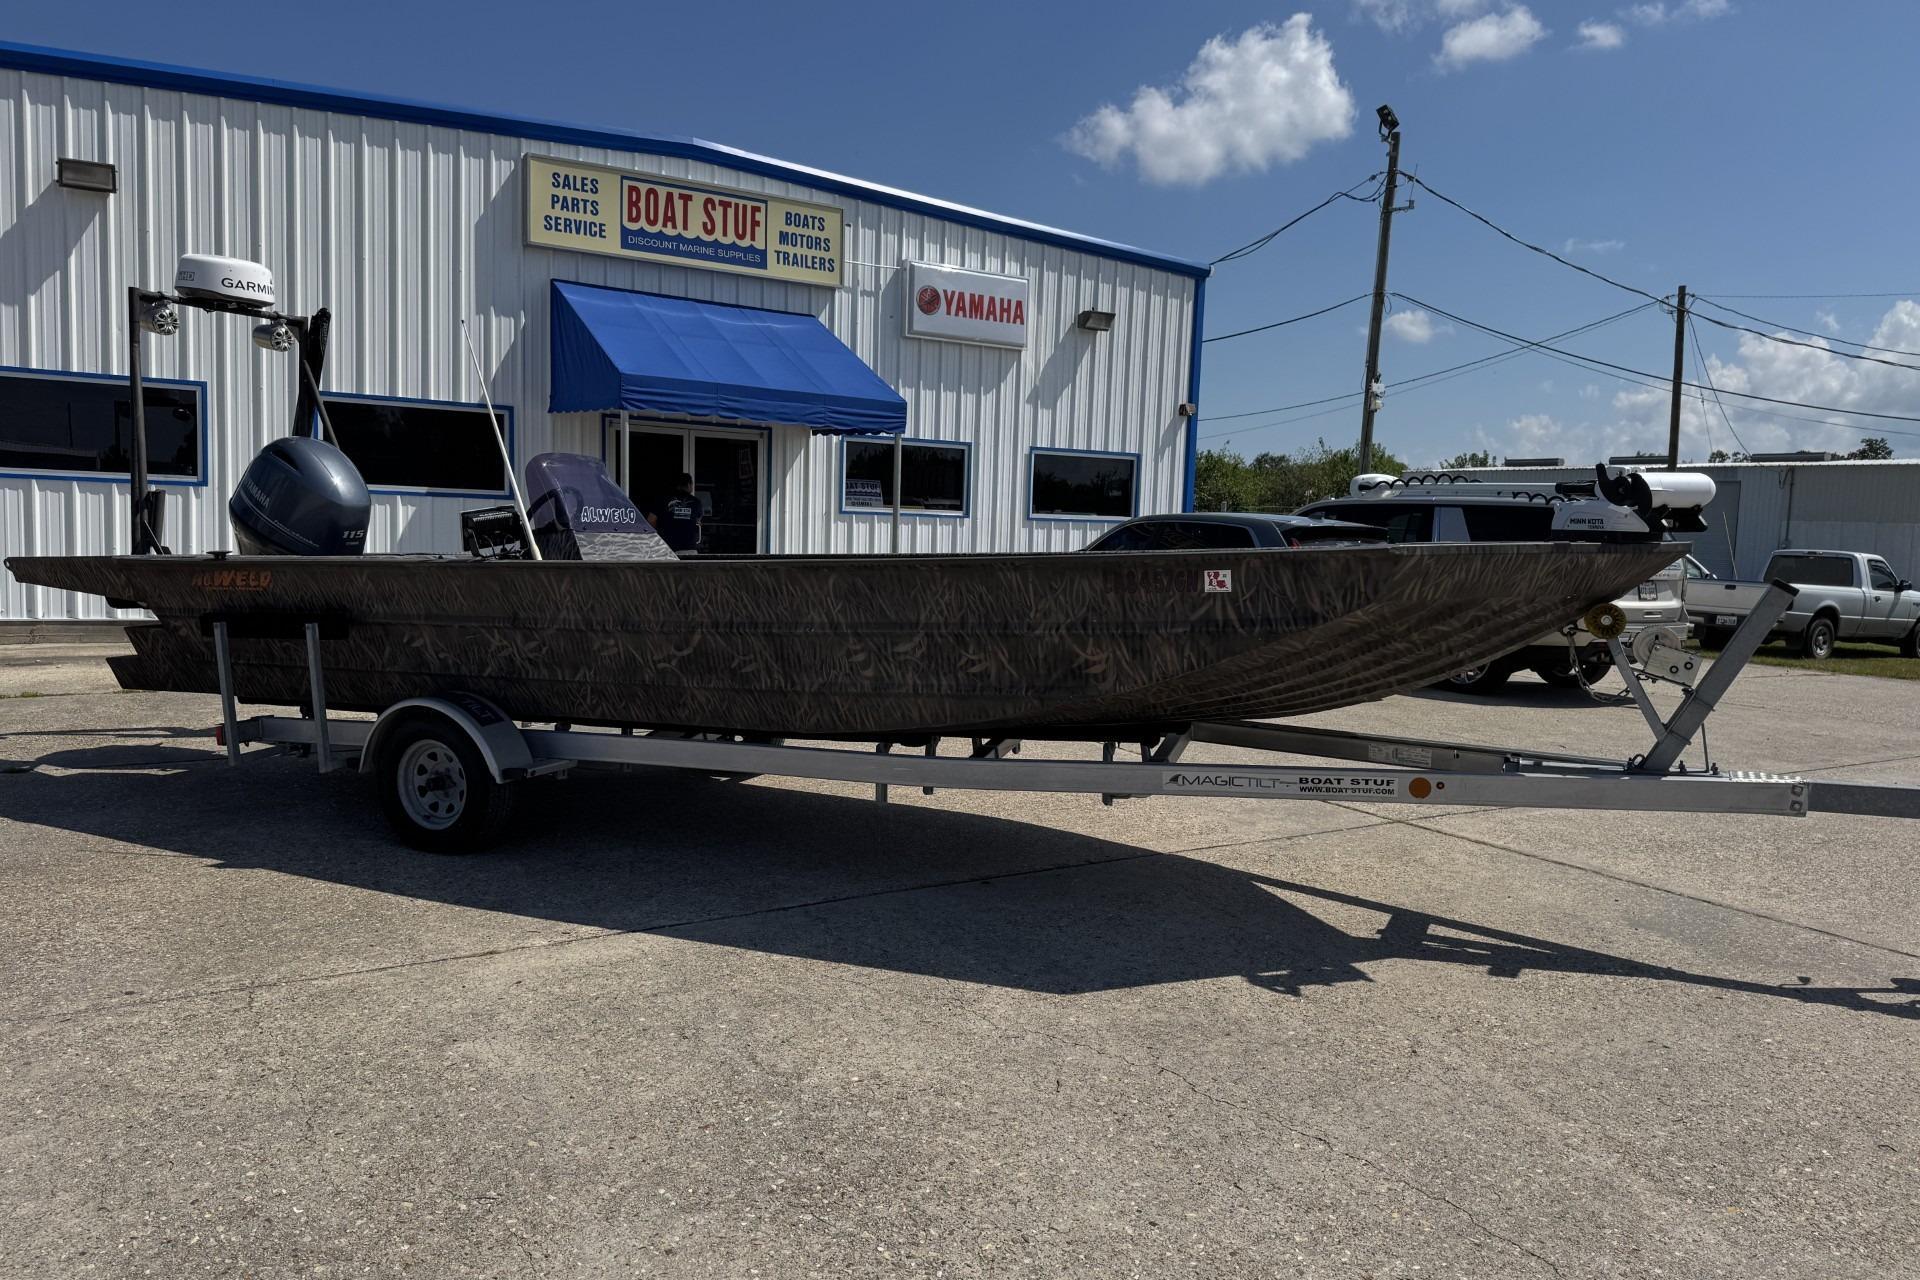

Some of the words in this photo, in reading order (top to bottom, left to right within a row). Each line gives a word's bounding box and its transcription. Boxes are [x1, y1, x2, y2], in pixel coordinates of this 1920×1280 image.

[551, 172, 599, 194] SALES
[551, 193, 599, 216] PARTS
[627, 184, 693, 231] BOAT
[702, 197, 762, 242] STUF
[543, 214, 607, 239] SERVICE
[785, 211, 825, 232] BOATS
[628, 235, 678, 251] DISCOUNT
[680, 243, 715, 256] MARINE
[717, 249, 761, 262] SUPPLIES
[778, 230, 831, 252] MOTORS
[774, 249, 835, 273] TRAILERS
[221, 277, 275, 296] GARMIN
[943, 289, 1025, 325] YAMAHA
[581, 506, 636, 524] ALWELD
[342, 530, 364, 539] 115
[1299, 777, 1344, 785] BOAT
[1350, 778, 1395, 787] STUF
